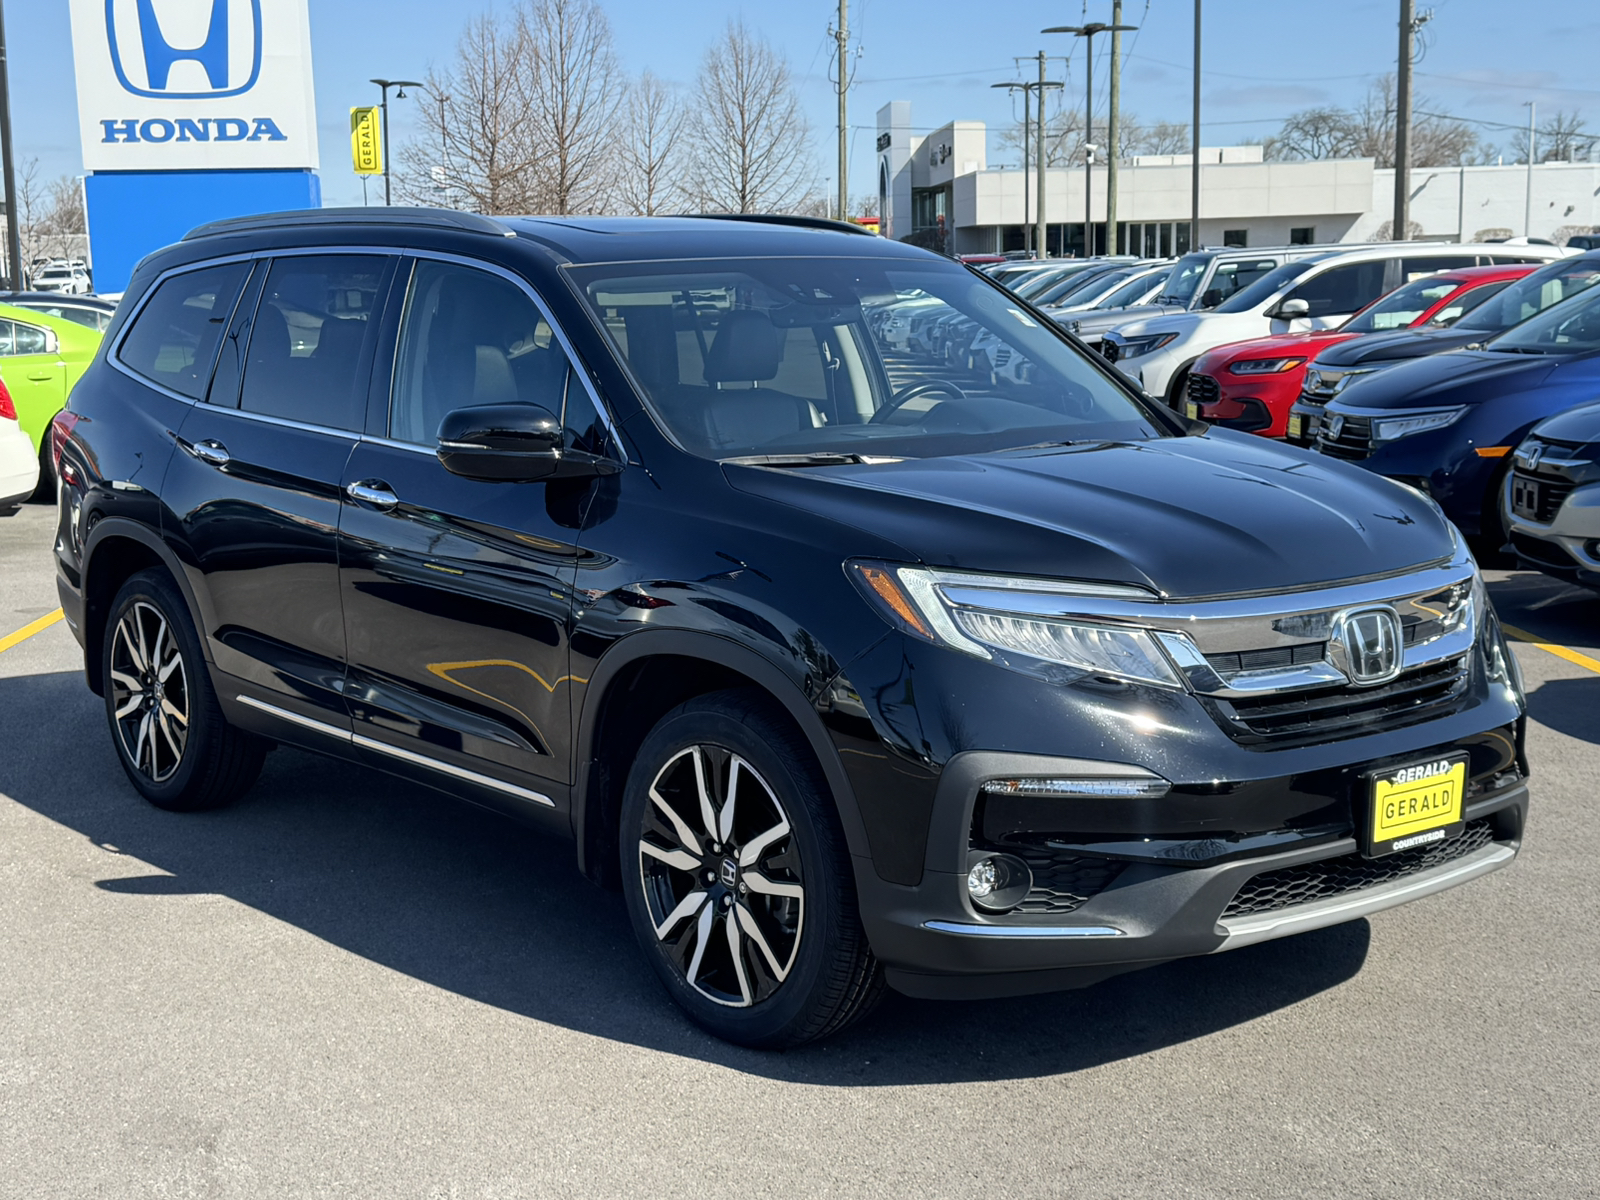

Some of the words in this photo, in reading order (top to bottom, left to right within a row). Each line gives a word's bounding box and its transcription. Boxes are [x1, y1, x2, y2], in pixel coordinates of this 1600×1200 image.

[100, 118, 288, 143] HONDA
[361, 115, 372, 165] GERALD
[1397, 760, 1449, 783] GERALD
[1386, 790, 1450, 819] GERALD
